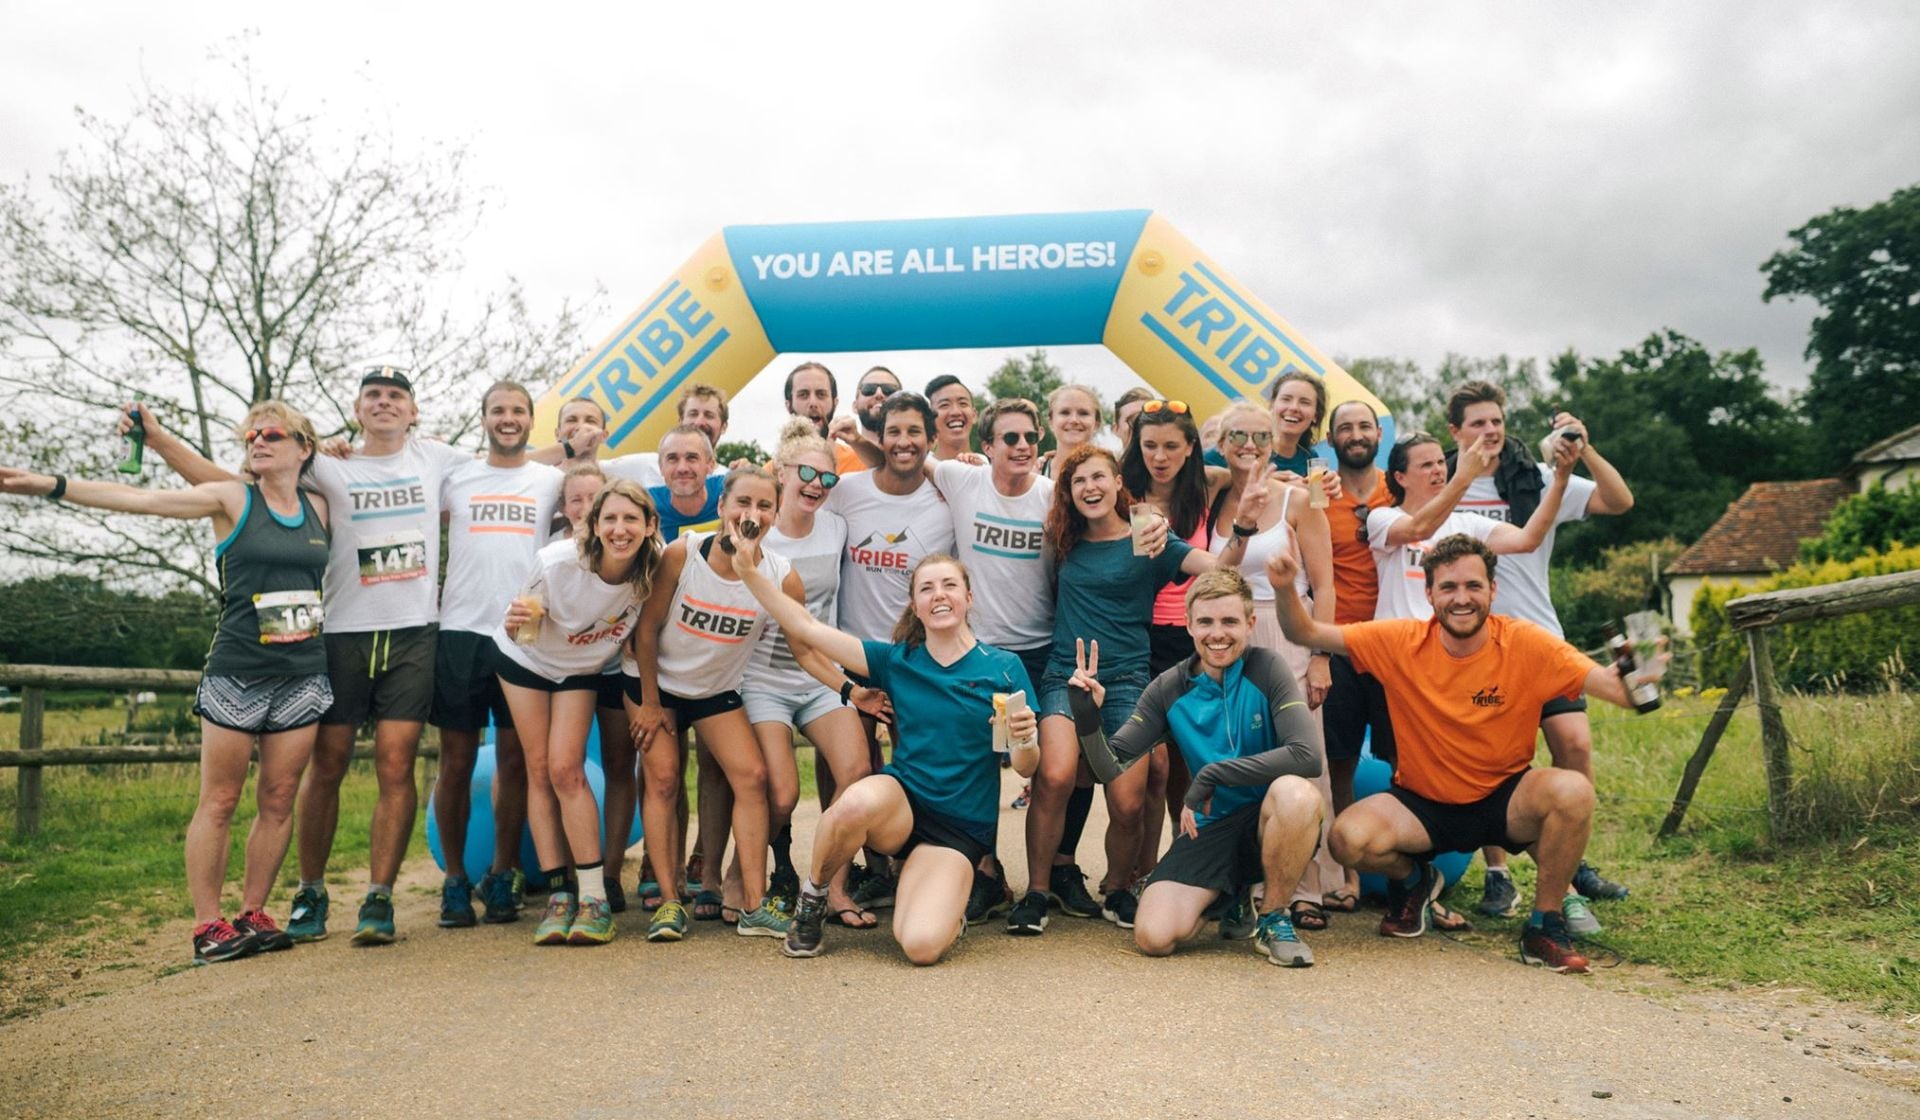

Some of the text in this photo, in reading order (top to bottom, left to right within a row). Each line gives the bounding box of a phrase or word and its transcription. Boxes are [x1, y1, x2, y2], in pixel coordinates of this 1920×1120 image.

[752, 241, 1116, 280] YOU ARE ALL HEROES!
[577, 289, 715, 422] RIBE
[349, 485, 425, 510] TRIBE
[469, 503, 536, 524] TRIBE
[973, 522, 1043, 550] TRIBE
[850, 546, 908, 569] TRIBE
[681, 603, 754, 636] TRIBE
